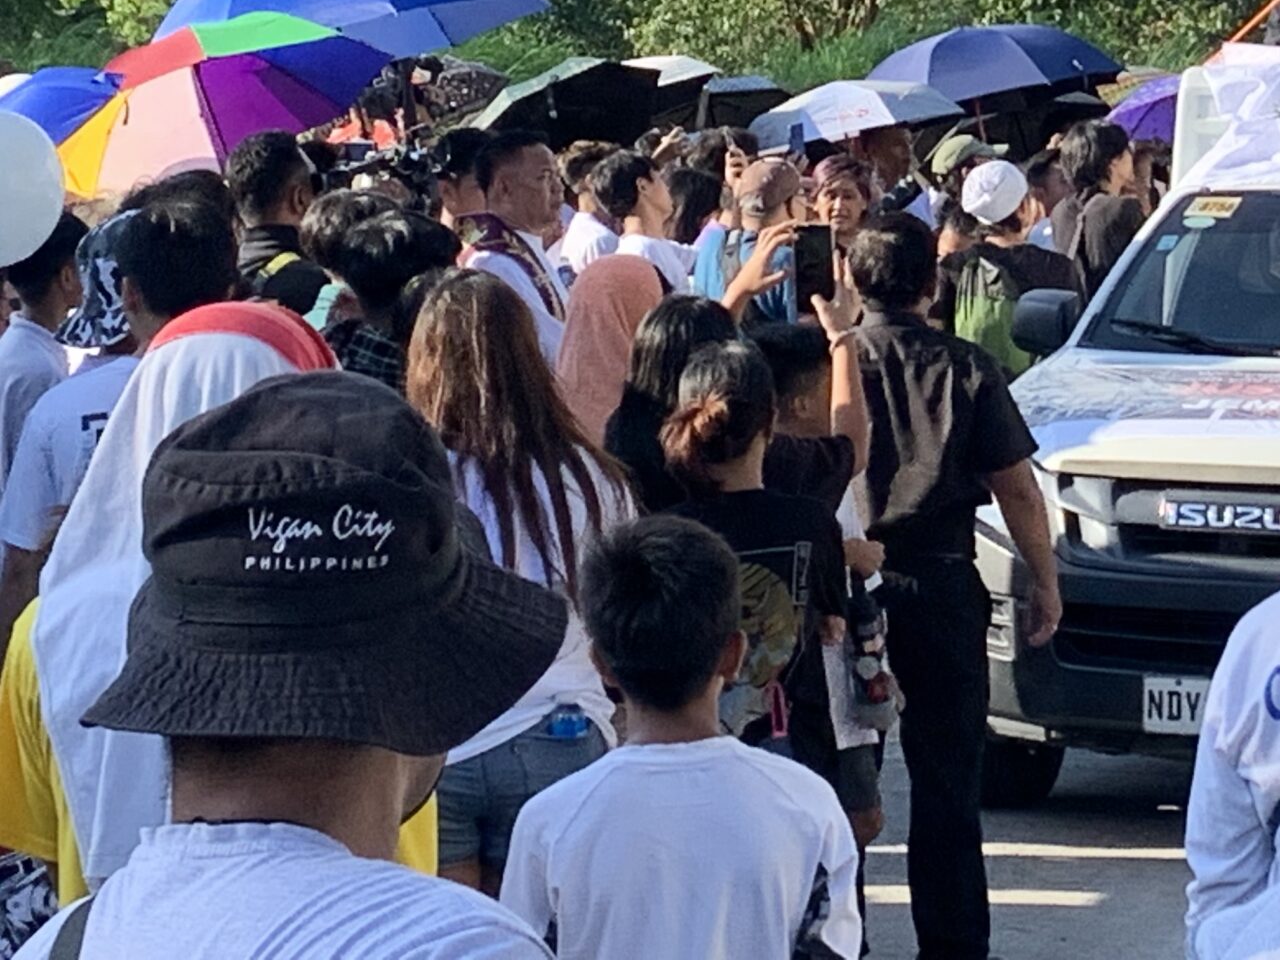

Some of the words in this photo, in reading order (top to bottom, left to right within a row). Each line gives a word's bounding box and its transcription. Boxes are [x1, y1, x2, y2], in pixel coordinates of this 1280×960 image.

[248, 506, 323, 554] Vigan
[332, 503, 396, 552] City
[244, 554, 389, 572] PHILIPPINES
[1148, 689, 1201, 722] NDY
